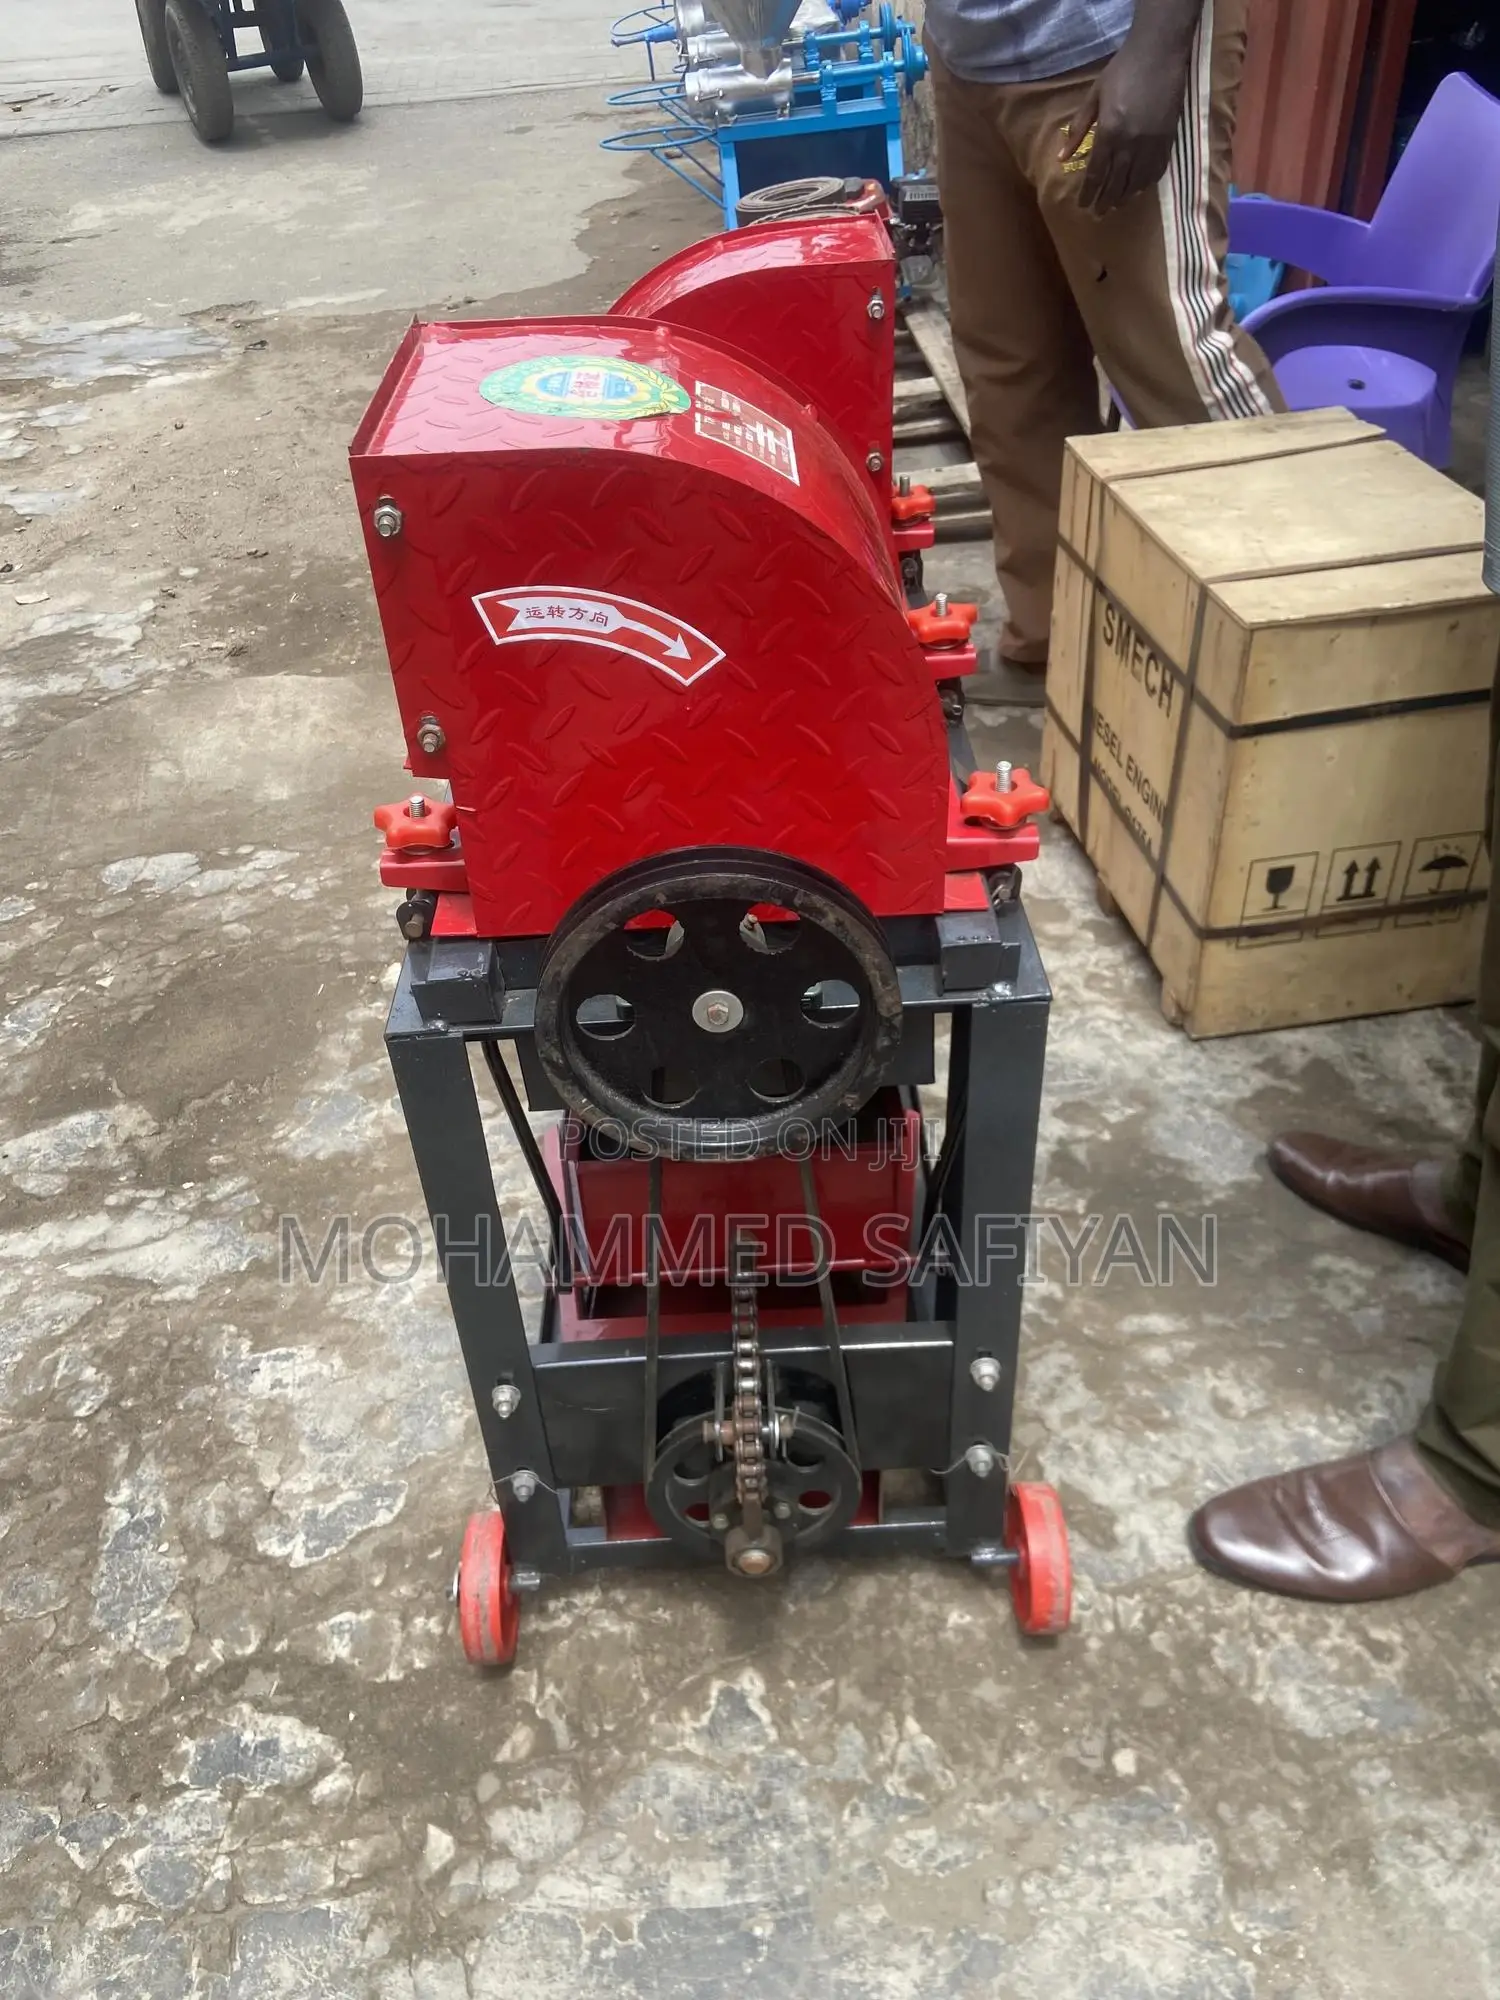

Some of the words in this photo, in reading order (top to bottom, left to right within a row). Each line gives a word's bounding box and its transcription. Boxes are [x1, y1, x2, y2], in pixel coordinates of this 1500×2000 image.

[525, 604, 609, 627] 运转方向
[1102, 602, 1174, 719] SMECH
[1125, 754, 1166, 823] ENGIN
